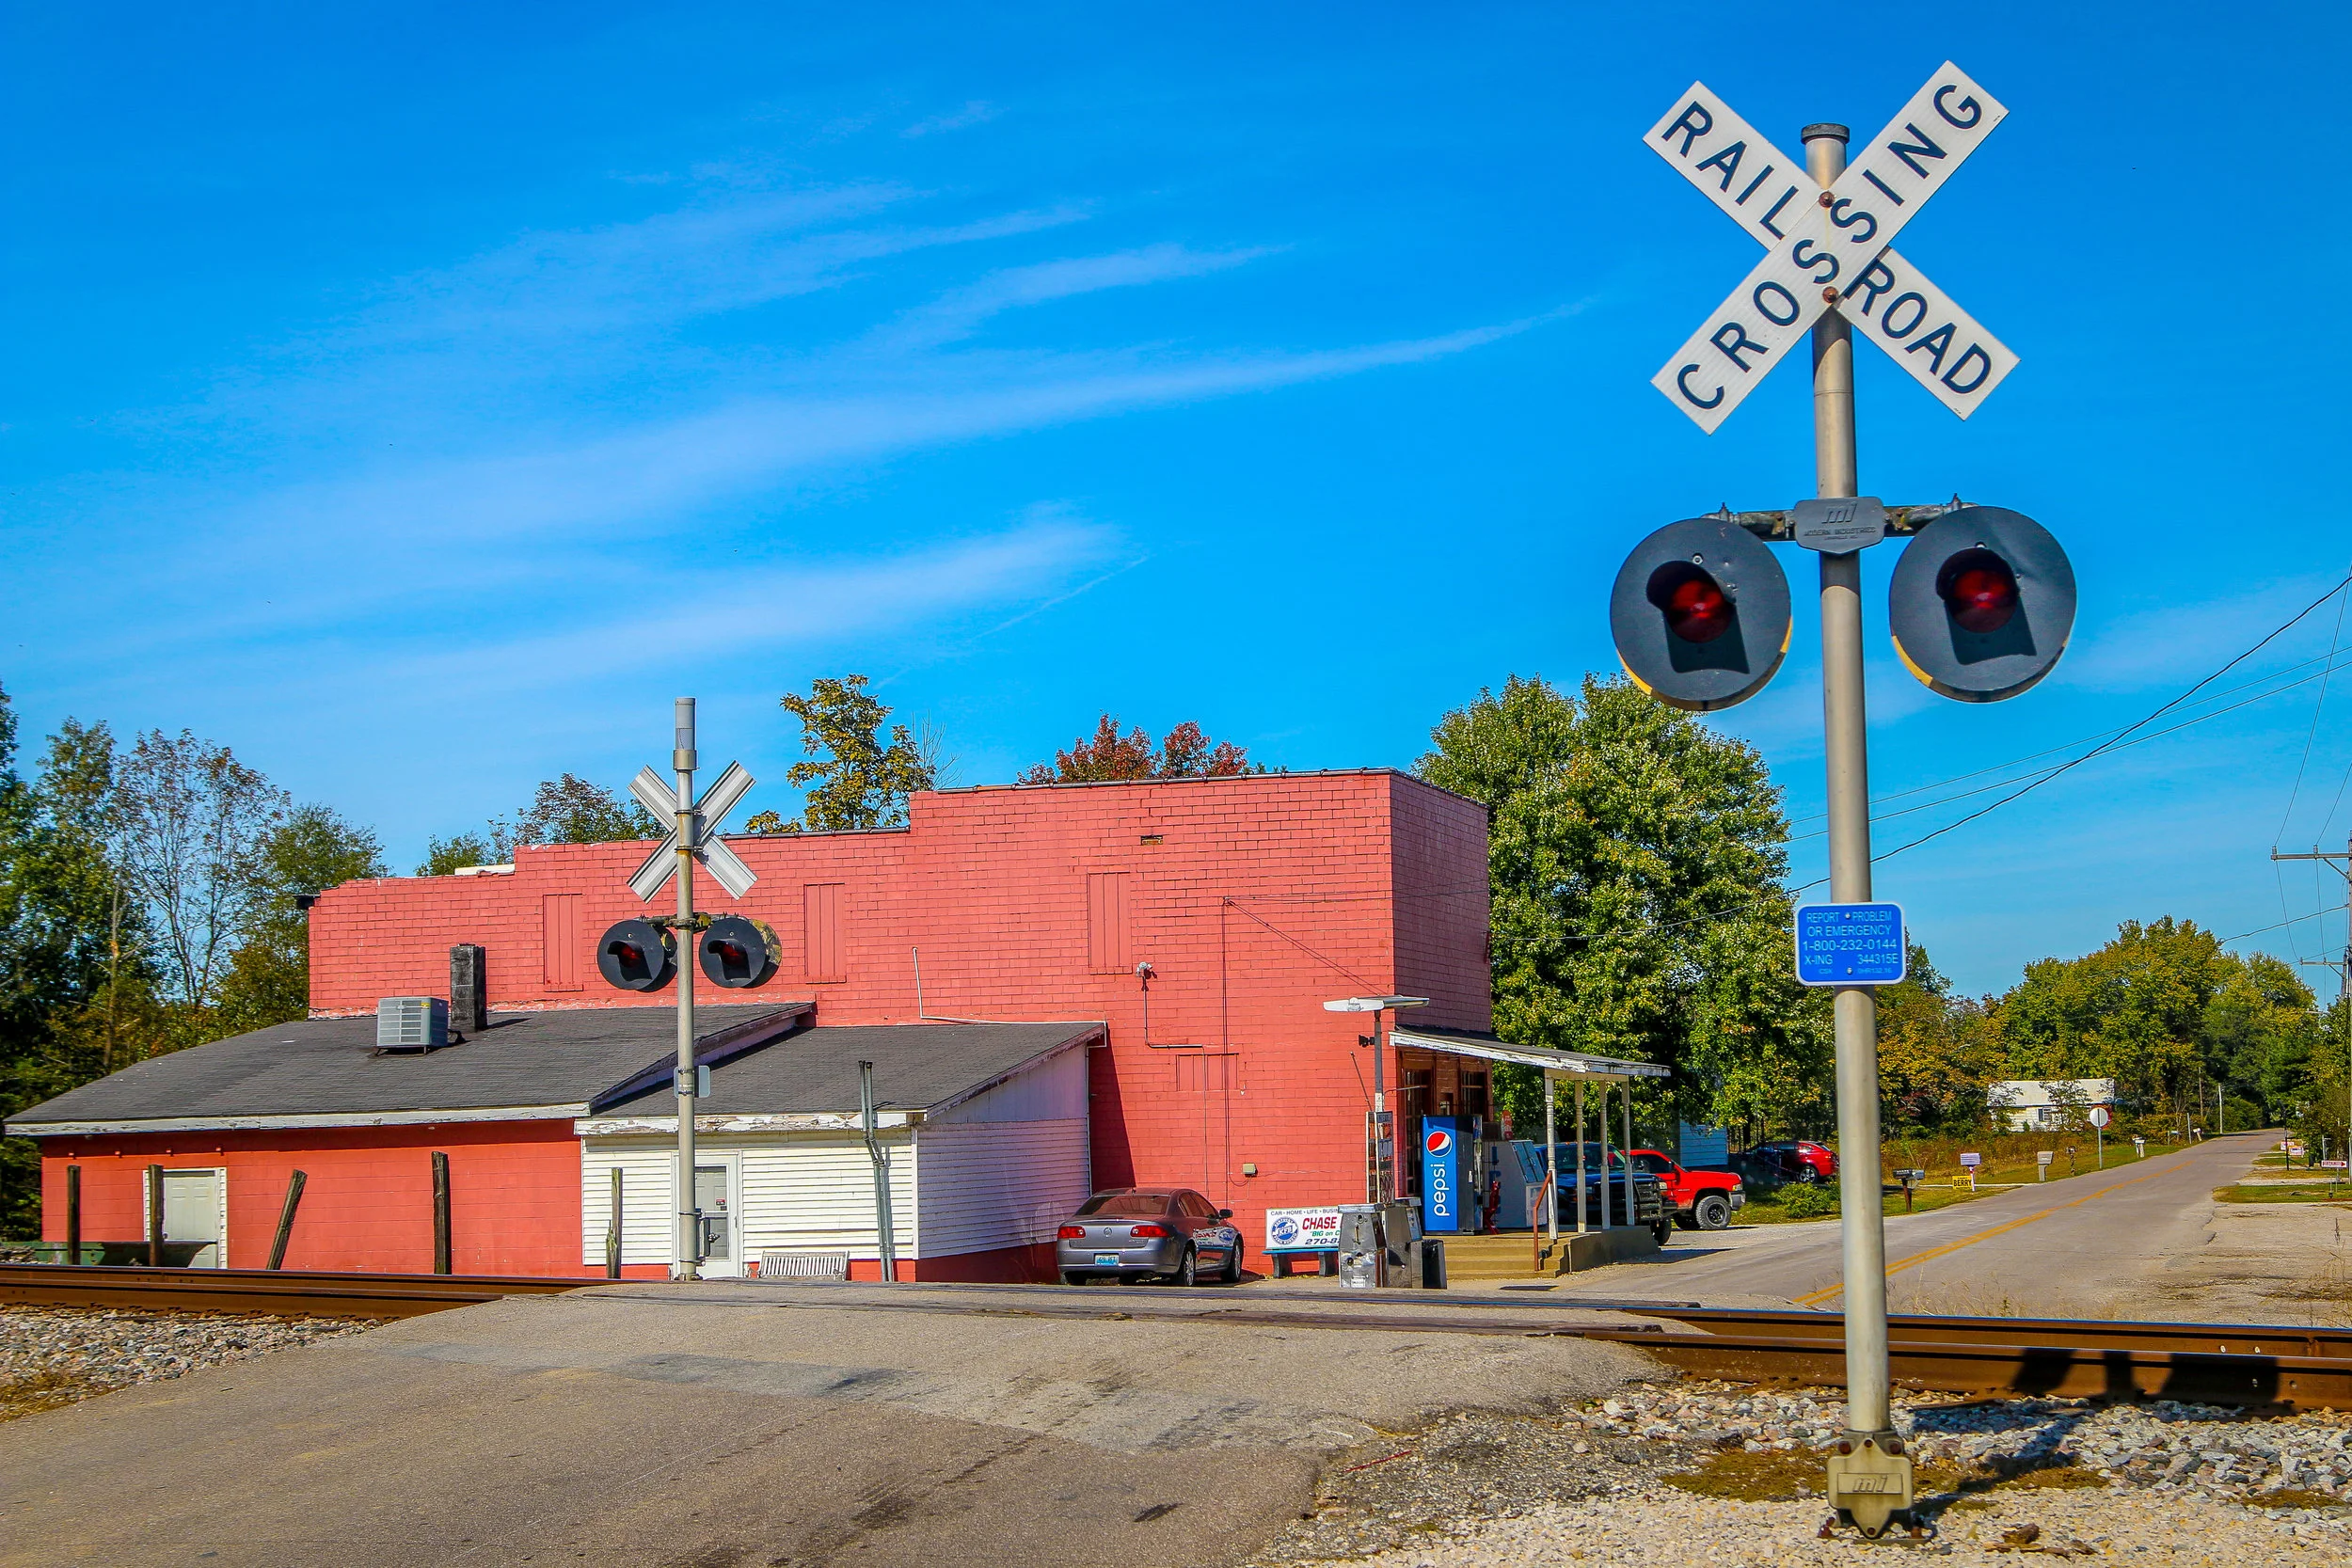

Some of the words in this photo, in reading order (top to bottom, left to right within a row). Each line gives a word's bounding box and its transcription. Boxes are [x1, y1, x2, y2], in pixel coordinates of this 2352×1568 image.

[1661, 101, 1799, 241] RAIL
[1843, 258, 1993, 394] ROAD
[1677, 84, 1982, 410] CROSSING
[1806, 912, 1840, 923] REPORT
[1852, 911, 1892, 922] PROBLEM
[1807, 926, 1823, 937] OR
[1826, 925, 1892, 937] EMERGENCY
[1803, 939, 1898, 952] 1-800-232-0144
[1804, 955, 1834, 965] X-ING
[1856, 953, 1899, 965] 344315E
[1431, 1162, 1450, 1216] pepsi
[1302, 1216, 1337, 1230] CHASE
